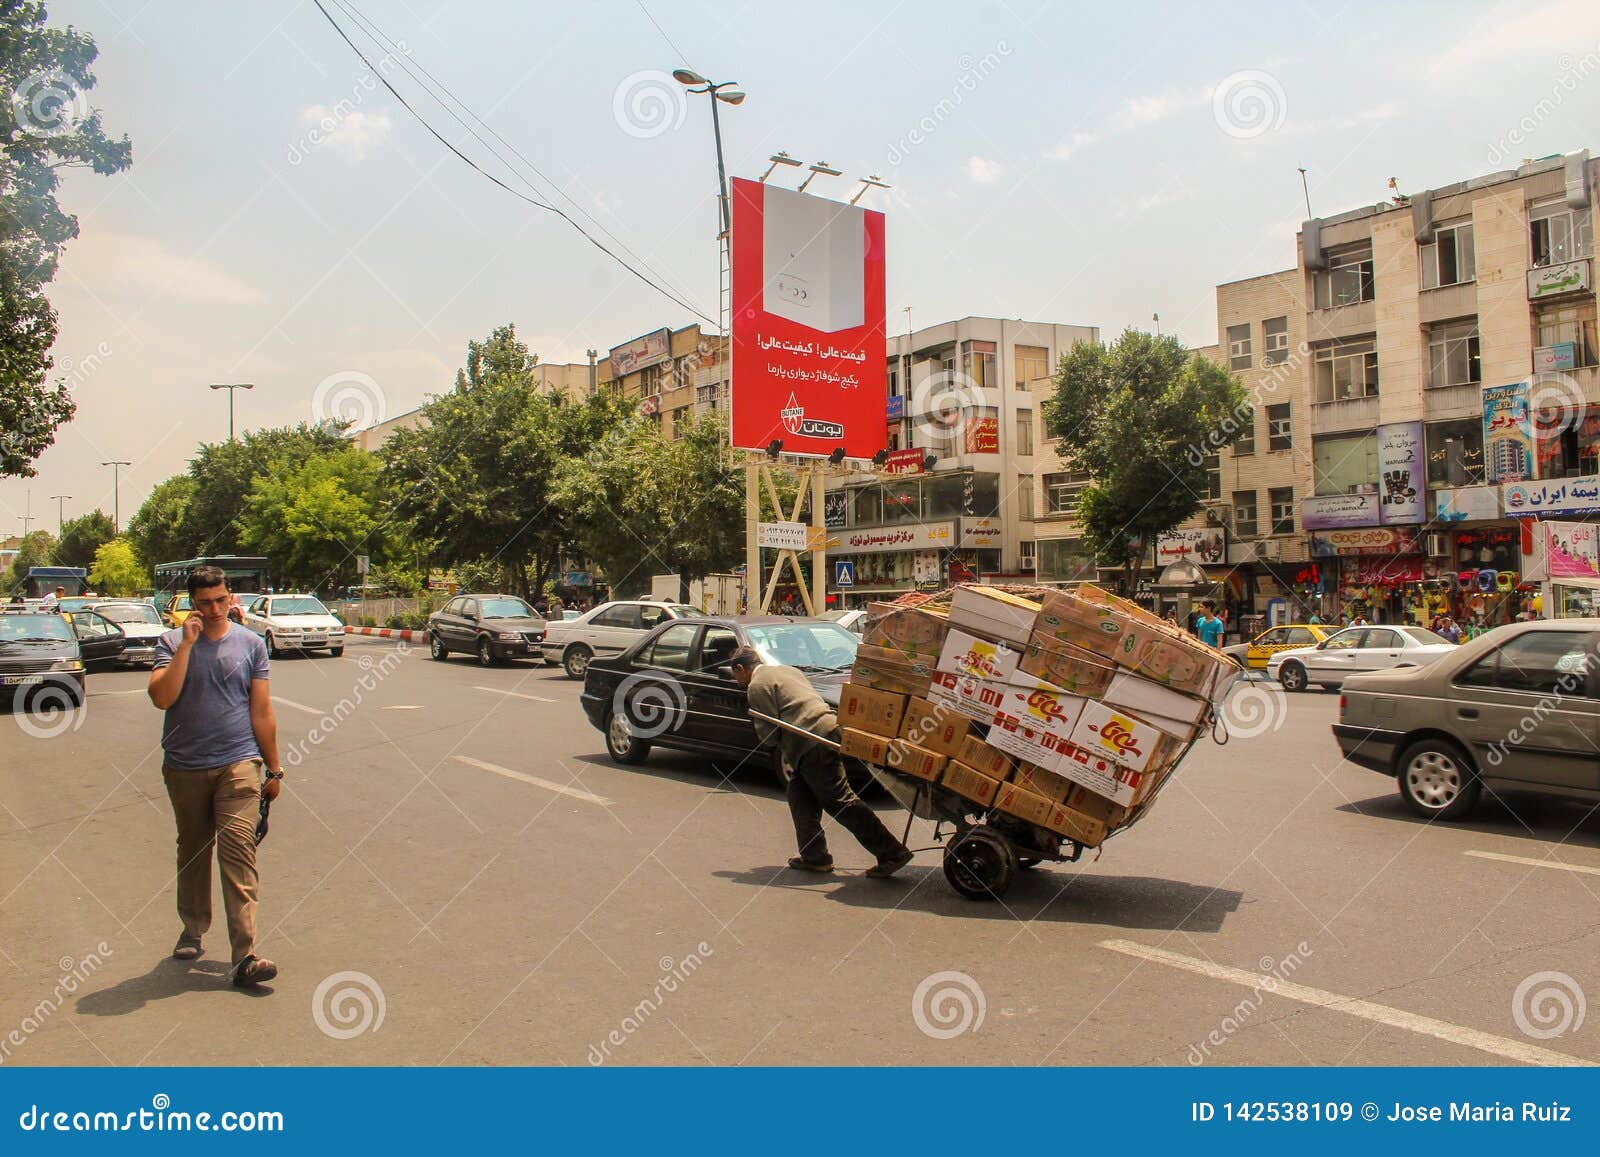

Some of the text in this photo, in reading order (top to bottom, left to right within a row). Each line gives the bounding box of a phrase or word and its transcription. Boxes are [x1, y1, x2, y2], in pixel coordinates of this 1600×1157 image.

[782, 340, 813, 357] کیفیت
[840, 349, 866, 365] قیمت
[767, 362, 859, 389] پکیج شوفاژ دیواری پارما
[781, 408, 803, 418] BUTANE
[803, 421, 841, 436] بوتان
[1530, 484, 1599, 506] بیمه ایران
